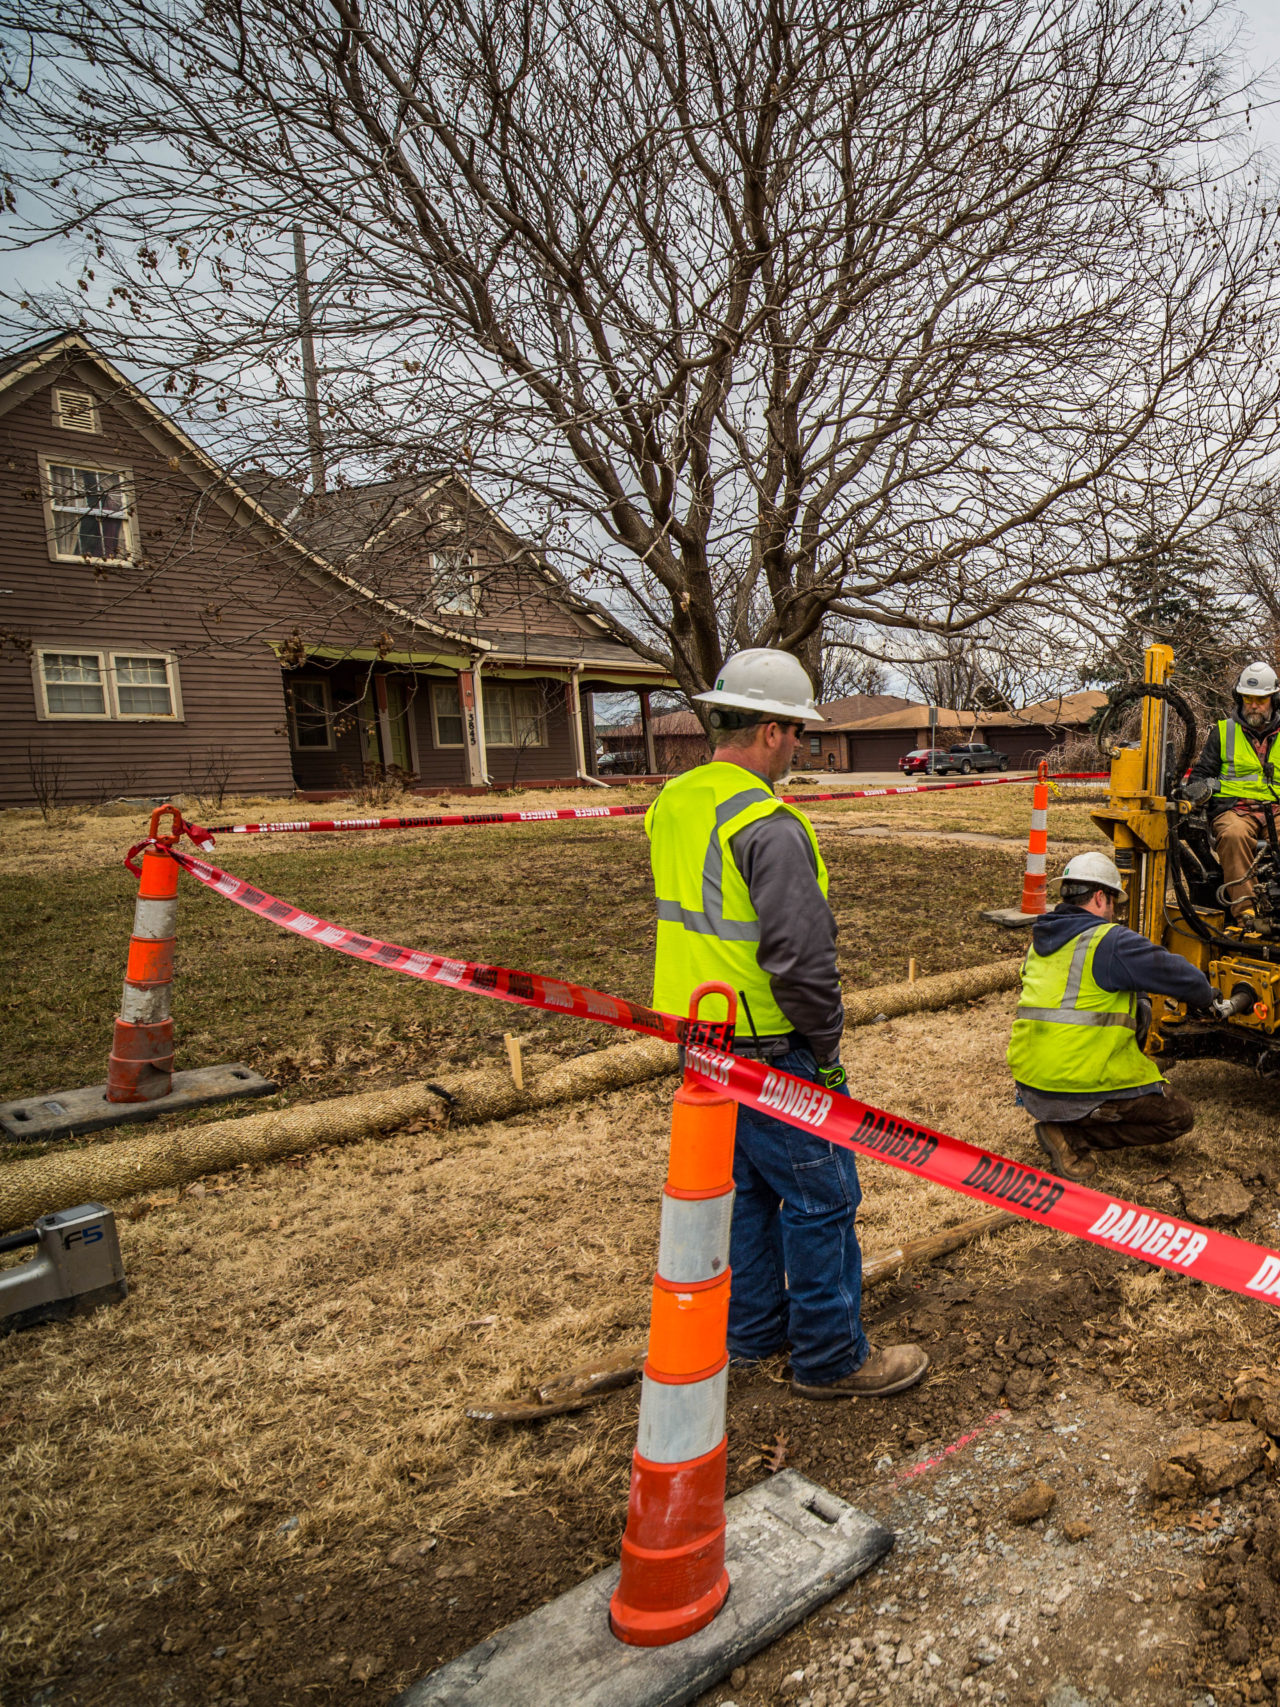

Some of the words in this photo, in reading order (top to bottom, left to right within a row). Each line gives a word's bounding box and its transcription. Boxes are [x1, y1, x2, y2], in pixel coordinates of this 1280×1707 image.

[399, 816, 442, 827] DANGER
[463, 814, 503, 824] DANGER
[520, 810, 558, 820] DANGER
[574, 807, 610, 817] DANGER
[685, 1046, 735, 1086] NGER
[757, 1071, 833, 1127] DANGER
[850, 1112, 939, 1168] DANGER
[962, 1156, 1065, 1214] DANGER
[1088, 1204, 1208, 1268] DANGER
[64, 1225, 104, 1250] F5
